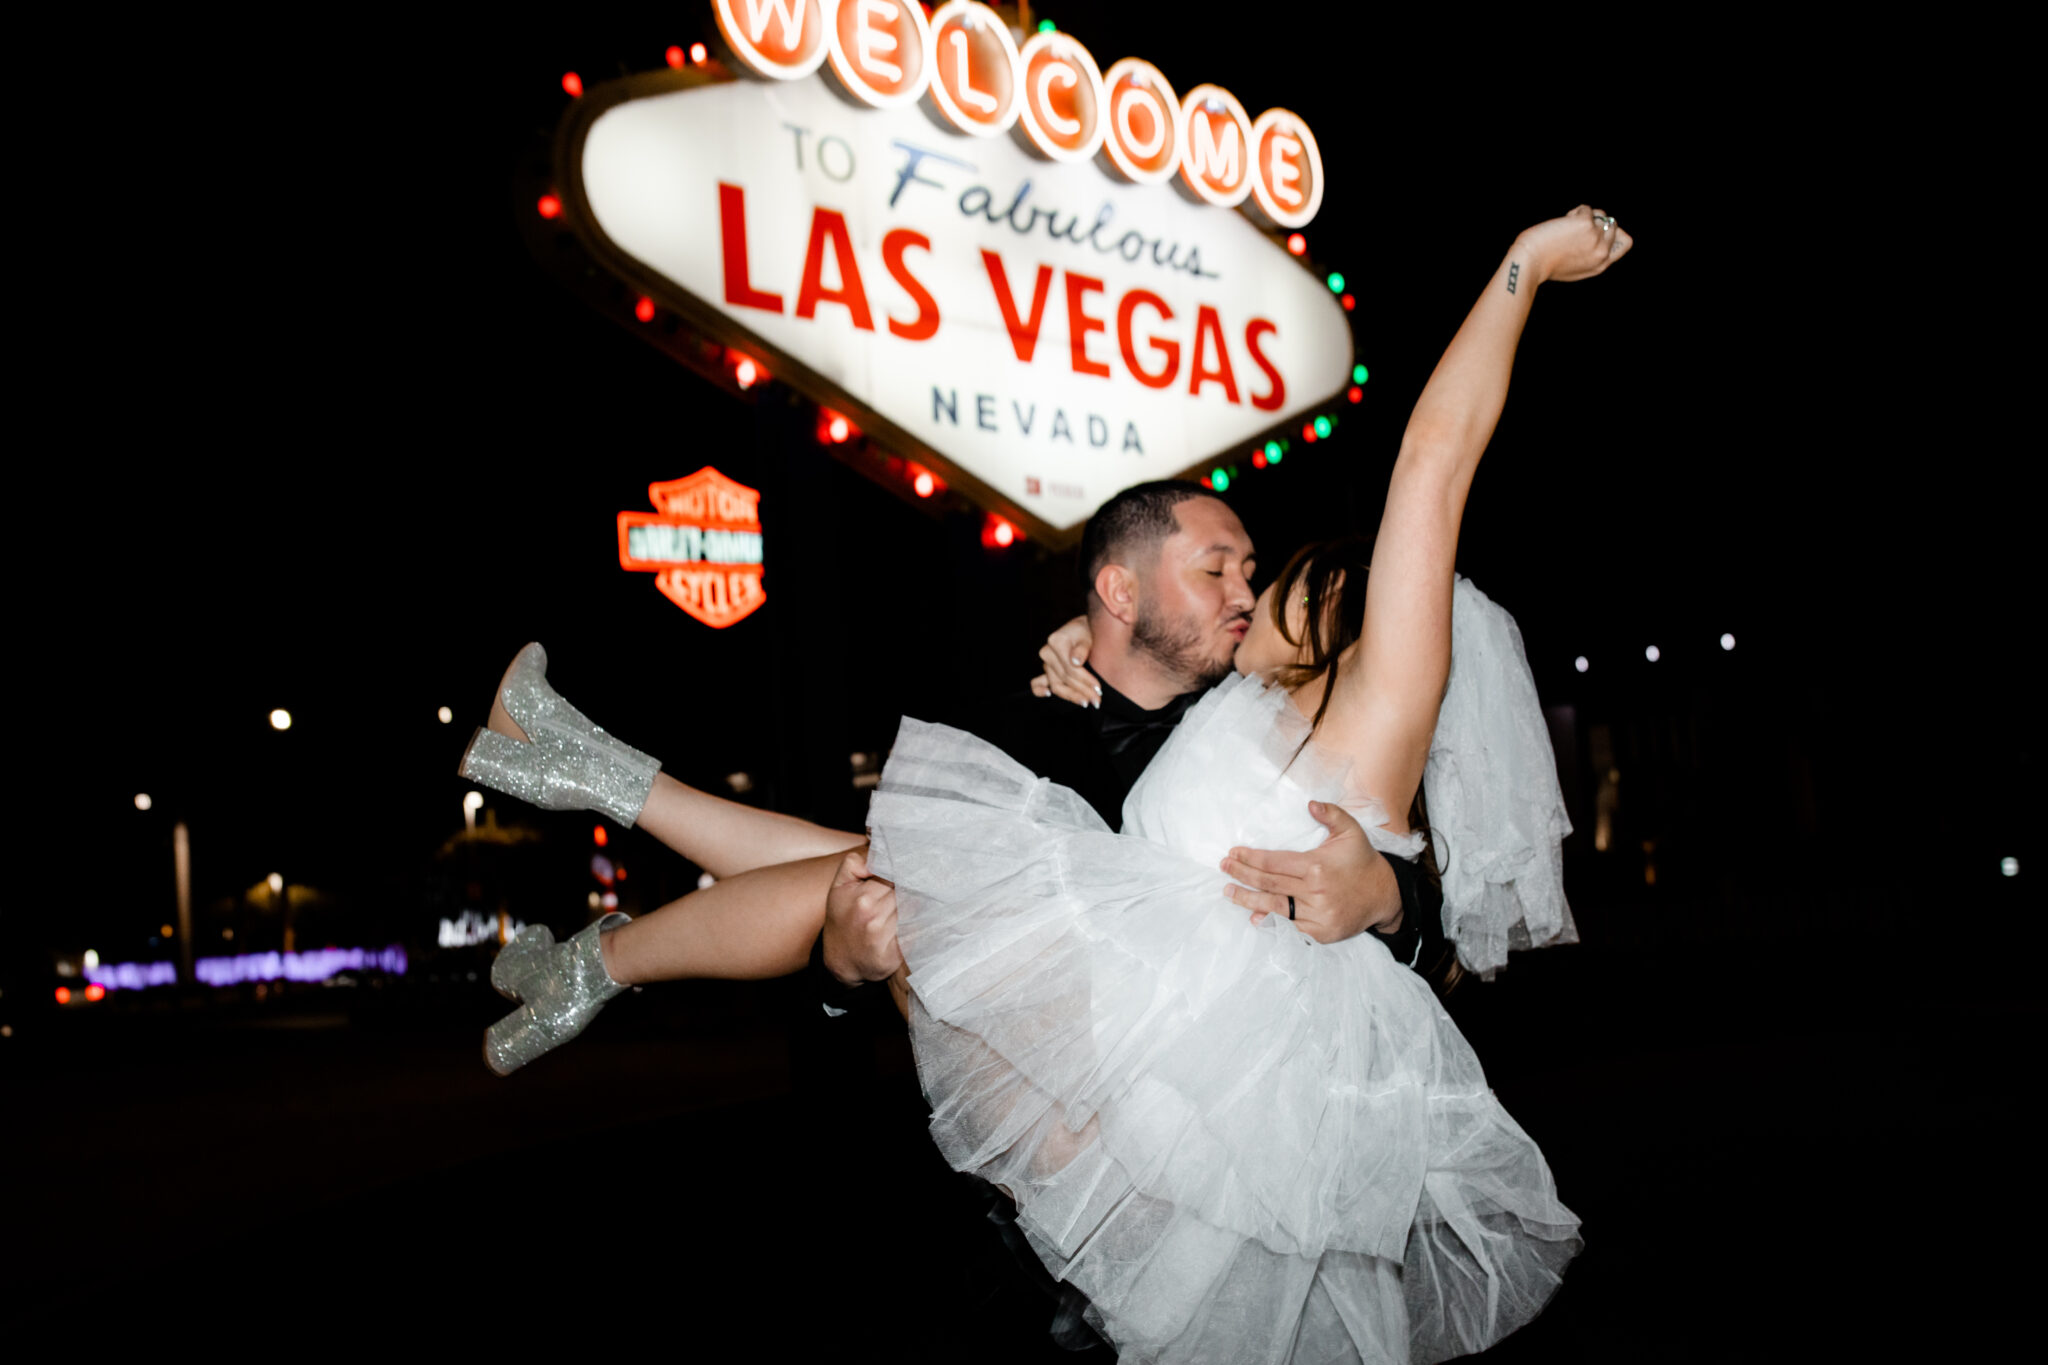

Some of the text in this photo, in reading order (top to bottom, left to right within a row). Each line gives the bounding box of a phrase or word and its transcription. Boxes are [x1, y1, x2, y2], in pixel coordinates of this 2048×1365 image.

[745, 0, 1303, 207] WELCOME
[782, 122, 1222, 280] TO Fabulous
[717, 180, 1287, 413] LAS VEGAS
[930, 384, 1146, 457] NEVADA
